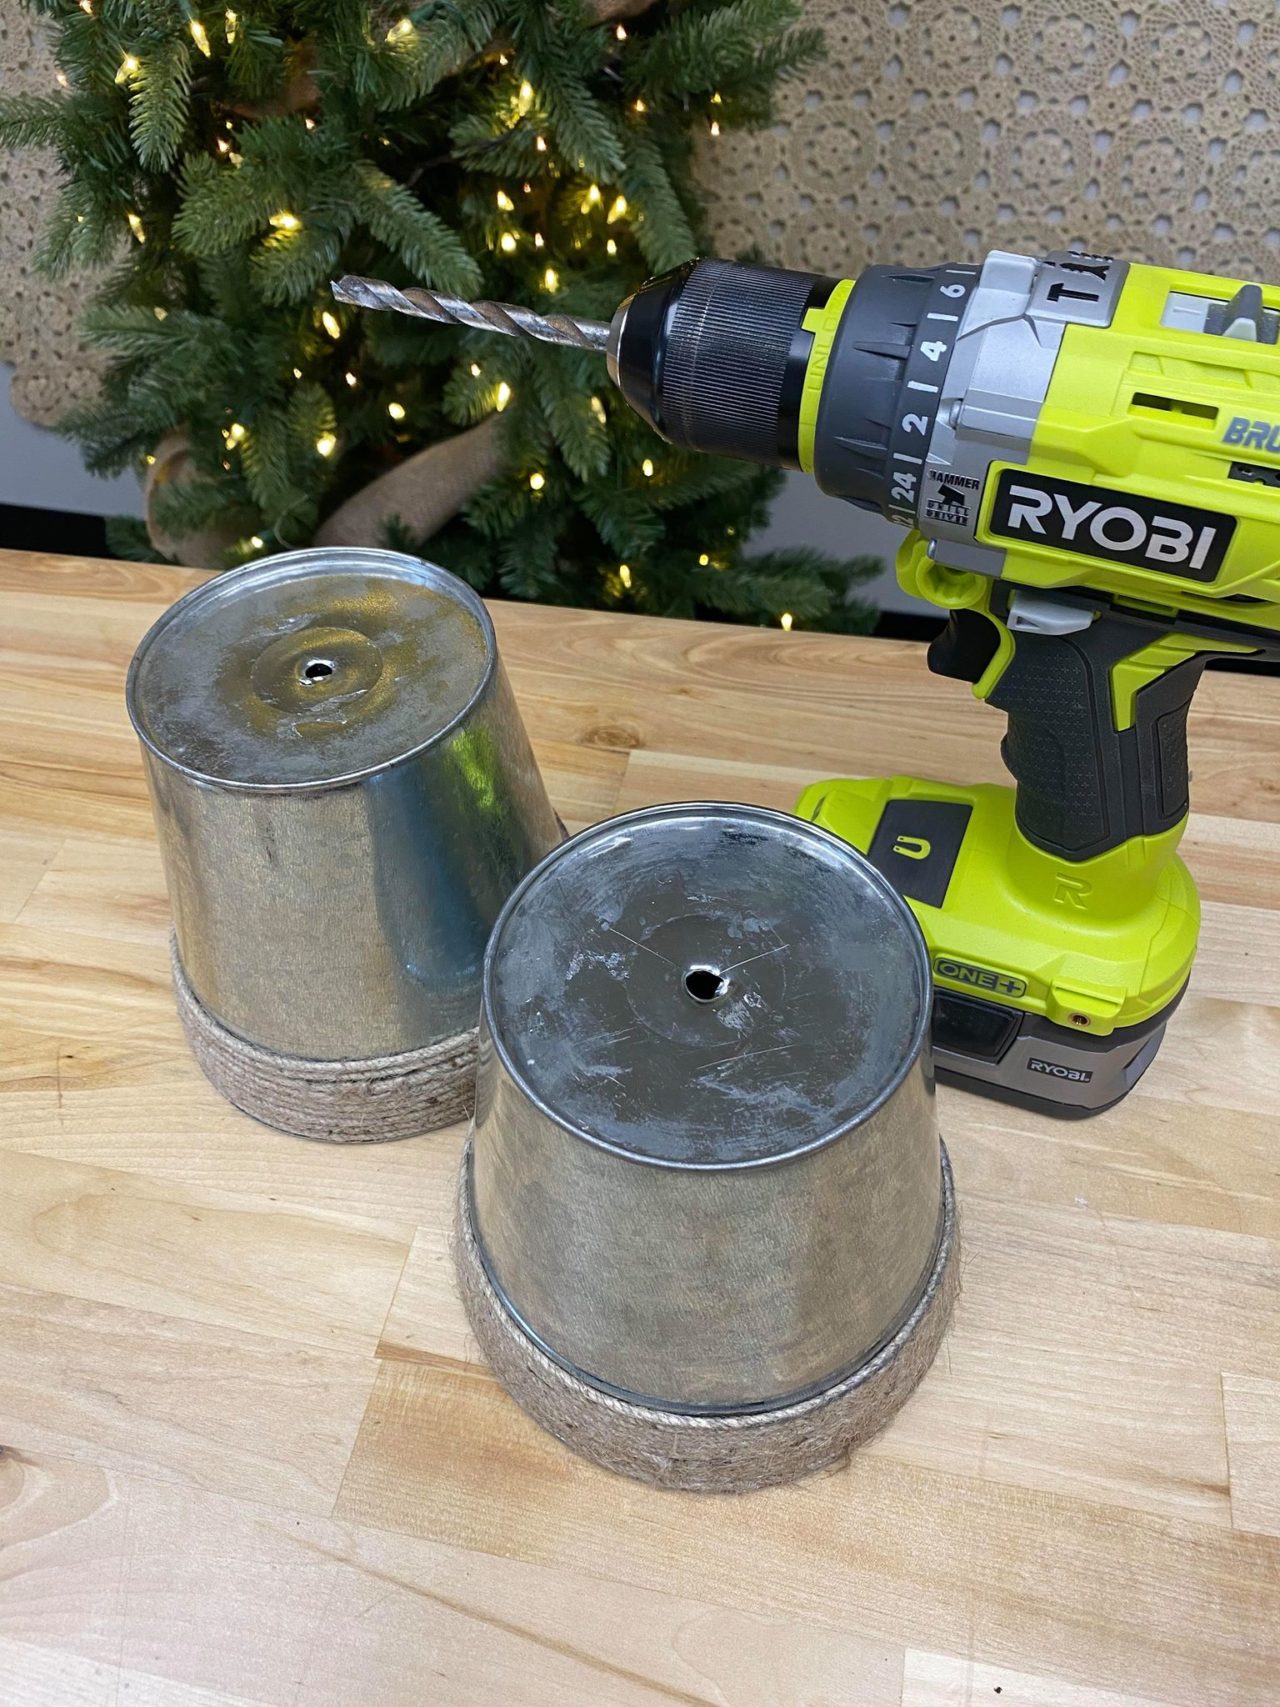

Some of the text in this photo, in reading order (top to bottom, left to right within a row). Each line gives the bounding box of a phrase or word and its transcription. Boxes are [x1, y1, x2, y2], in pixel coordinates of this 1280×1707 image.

[939, 284, 966, 299] 6
[919, 341, 947, 362] 4
[901, 413, 929, 436] 2
[891, 472, 917, 503] 24
[1007, 484, 1217, 570] RYOBI
[1053, 872, 1093, 911] R
[1029, 1060, 1087, 1082] RYOBI
